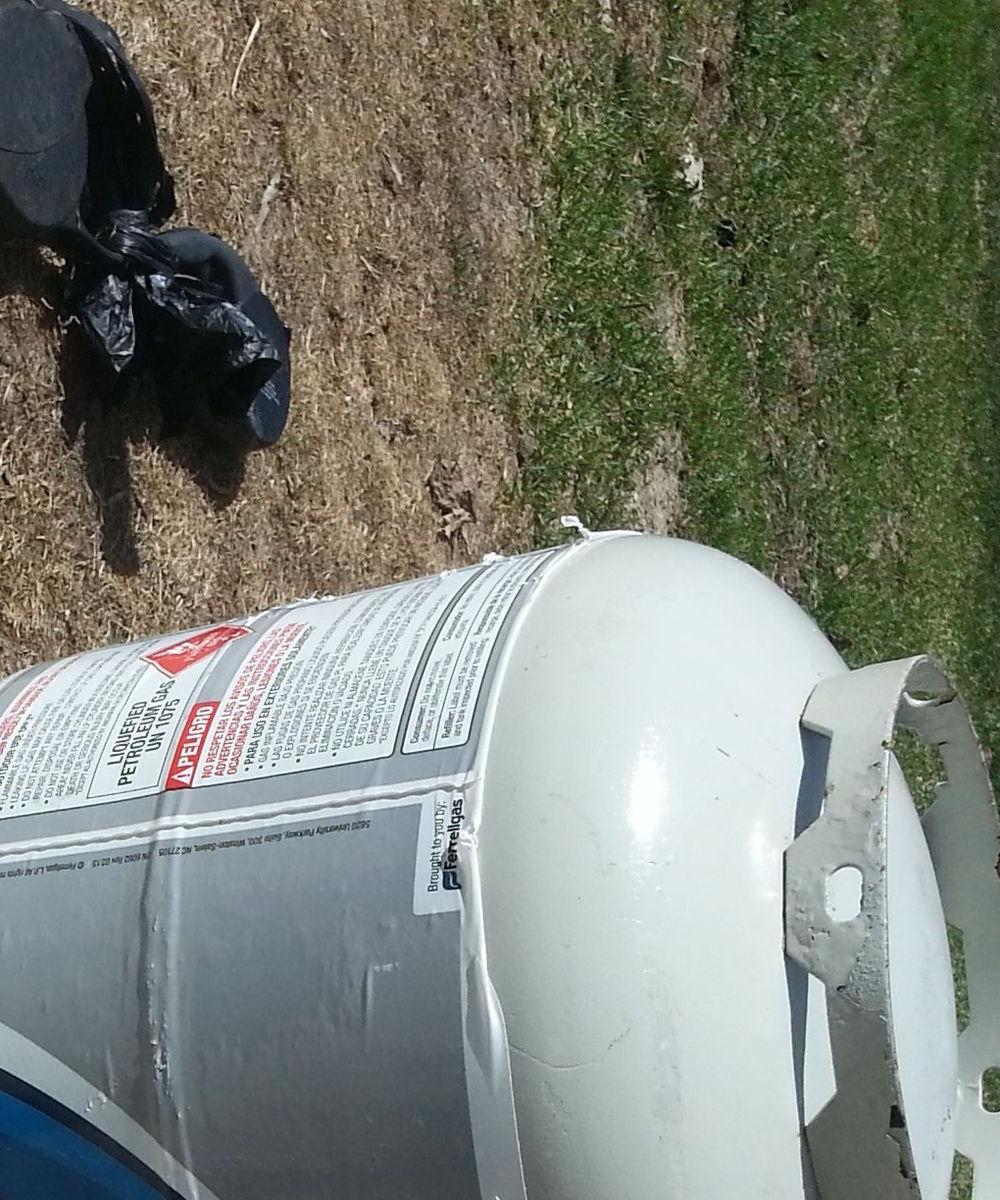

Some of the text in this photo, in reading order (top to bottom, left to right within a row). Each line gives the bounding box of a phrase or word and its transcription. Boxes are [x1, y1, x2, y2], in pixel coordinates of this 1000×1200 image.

[323, 690, 335, 700] DE
[448, 691, 461, 710] Label
[221, 701, 236, 717] LOS
[244, 661, 293, 765] PARA USO EN EXTERIORES
[283, 709, 295, 720] DE
[366, 714, 383, 744] GRAVES
[376, 696, 387, 706] LA
[410, 694, 430, 744] Consumer: Do
[107, 701, 147, 766] LIQUEFIED
[117, 705, 162, 786] PETROLEUM
[151, 680, 175, 703] GAS
[145, 699, 180, 752] UN 1075
[214, 710, 244, 776] ADVERTENCIAS
[240, 687, 255, 702] LAS
[263, 703, 285, 746] INFLAMABLE
[275, 720, 291, 745] FUGAS
[284, 703, 307, 751] EXPLOSIONES
[299, 713, 316, 743] INTENTE
[309, 701, 331, 744] PROVEEDOR
[335, 710, 351, 737] UTILICE
[357, 723, 369, 734] SU
[441, 710, 456, 739] Refiller:
[454, 723, 463, 736] and
[178, 706, 213, 767] PELIGRO
[205, 718, 229, 763] RESPETAR
[227, 722, 251, 775] OCASIONAR
[331, 738, 343, 751] NO
[354, 735, 366, 747] DE
[258, 747, 270, 763] GAS
[271, 745, 283, 761] LAS
[295, 744, 307, 757] NO
[306, 744, 318, 755] EL
[25, 775, 36, 790] NOT
[48, 773, 59, 786] NOT
[65, 771, 80, 796] DEATH
[201, 765, 214, 779] NO
[10, 774, 27, 803] LEAKING
[21, 790, 32, 801] DO
[44, 787, 55, 798] DO
[435, 818, 445, 836] you
[443, 799, 465, 870] Ferrellgas
[432, 838, 442, 849] to
[427, 851, 441, 892] Brought
